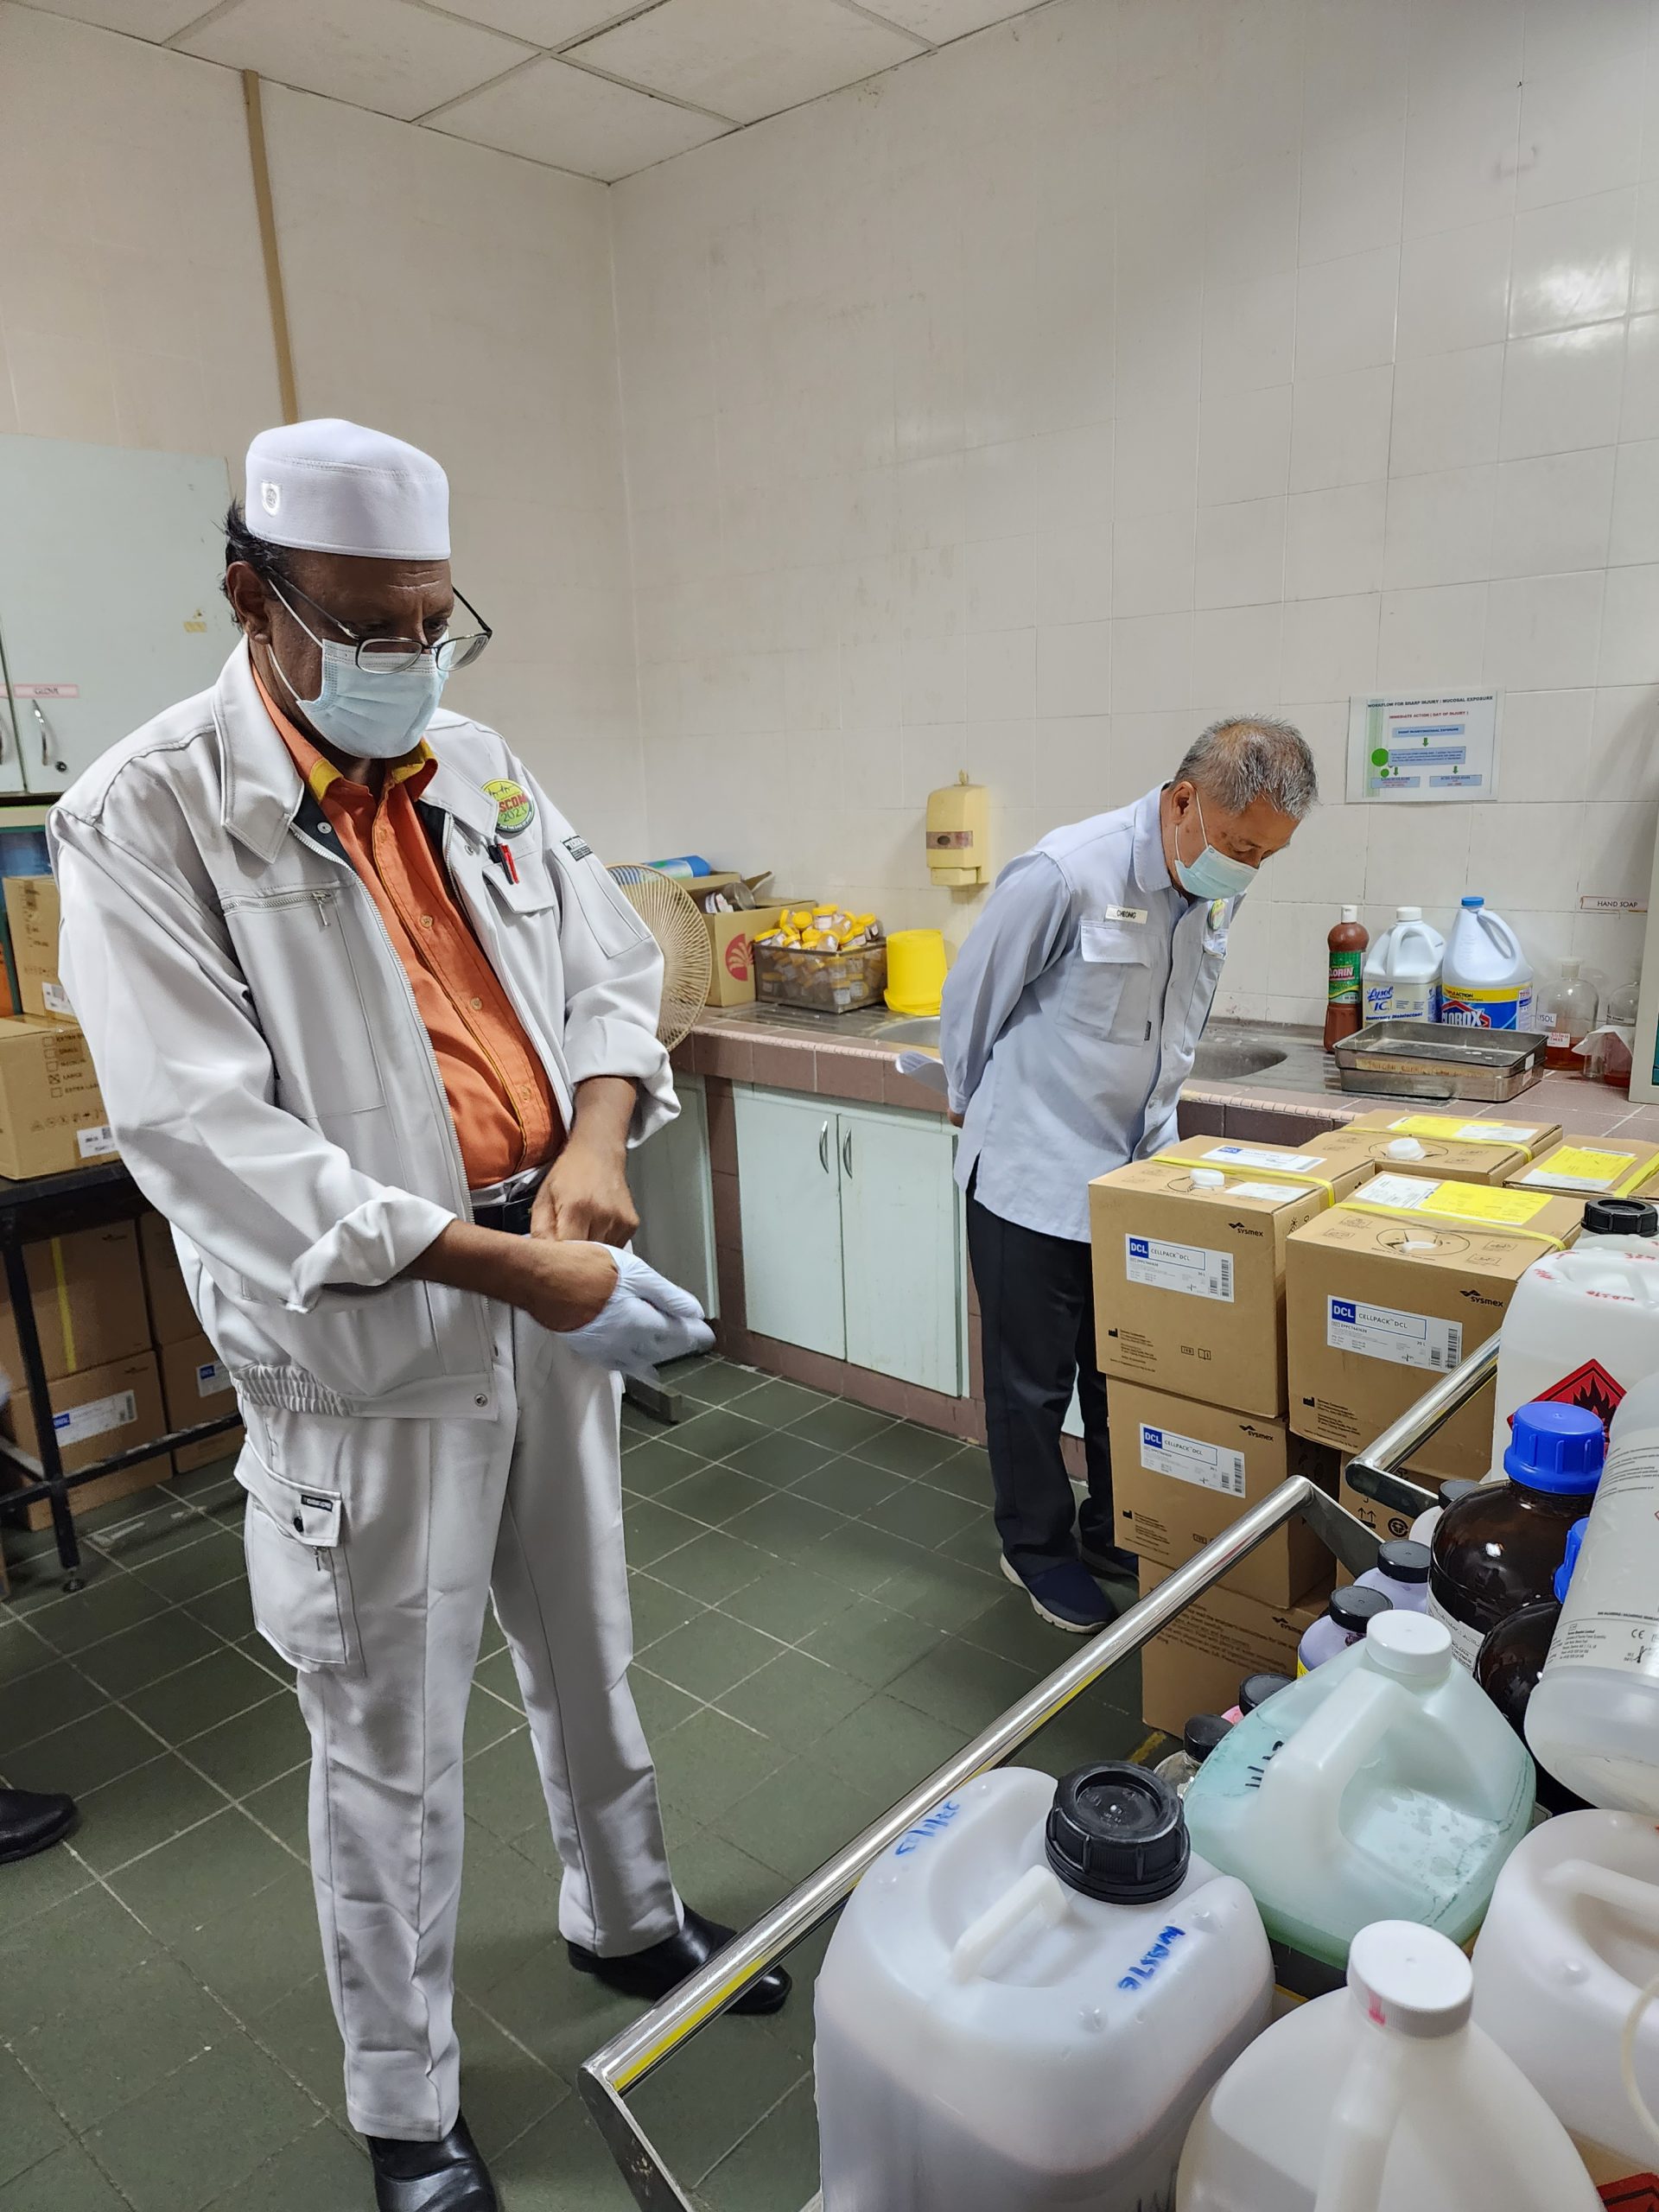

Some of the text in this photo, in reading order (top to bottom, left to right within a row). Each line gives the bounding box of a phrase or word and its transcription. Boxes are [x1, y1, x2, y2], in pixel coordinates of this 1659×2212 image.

[1116, 910, 1136, 919] CHEONG
[1367, 986, 1394, 1001] Lysol
[1236, 1227, 1264, 1237] sysmex
[1130, 1242, 1148, 1255] DCL
[1470, 1296, 1504, 1307] sysmex
[1333, 1305, 1355, 1319] DCL
[1394, 1320, 1408, 1329] DCL
[1145, 1432, 1162, 1445] DCL
[1247, 1430, 1274, 1442] sysmex
[1117, 1924, 1187, 1992] WASTE
